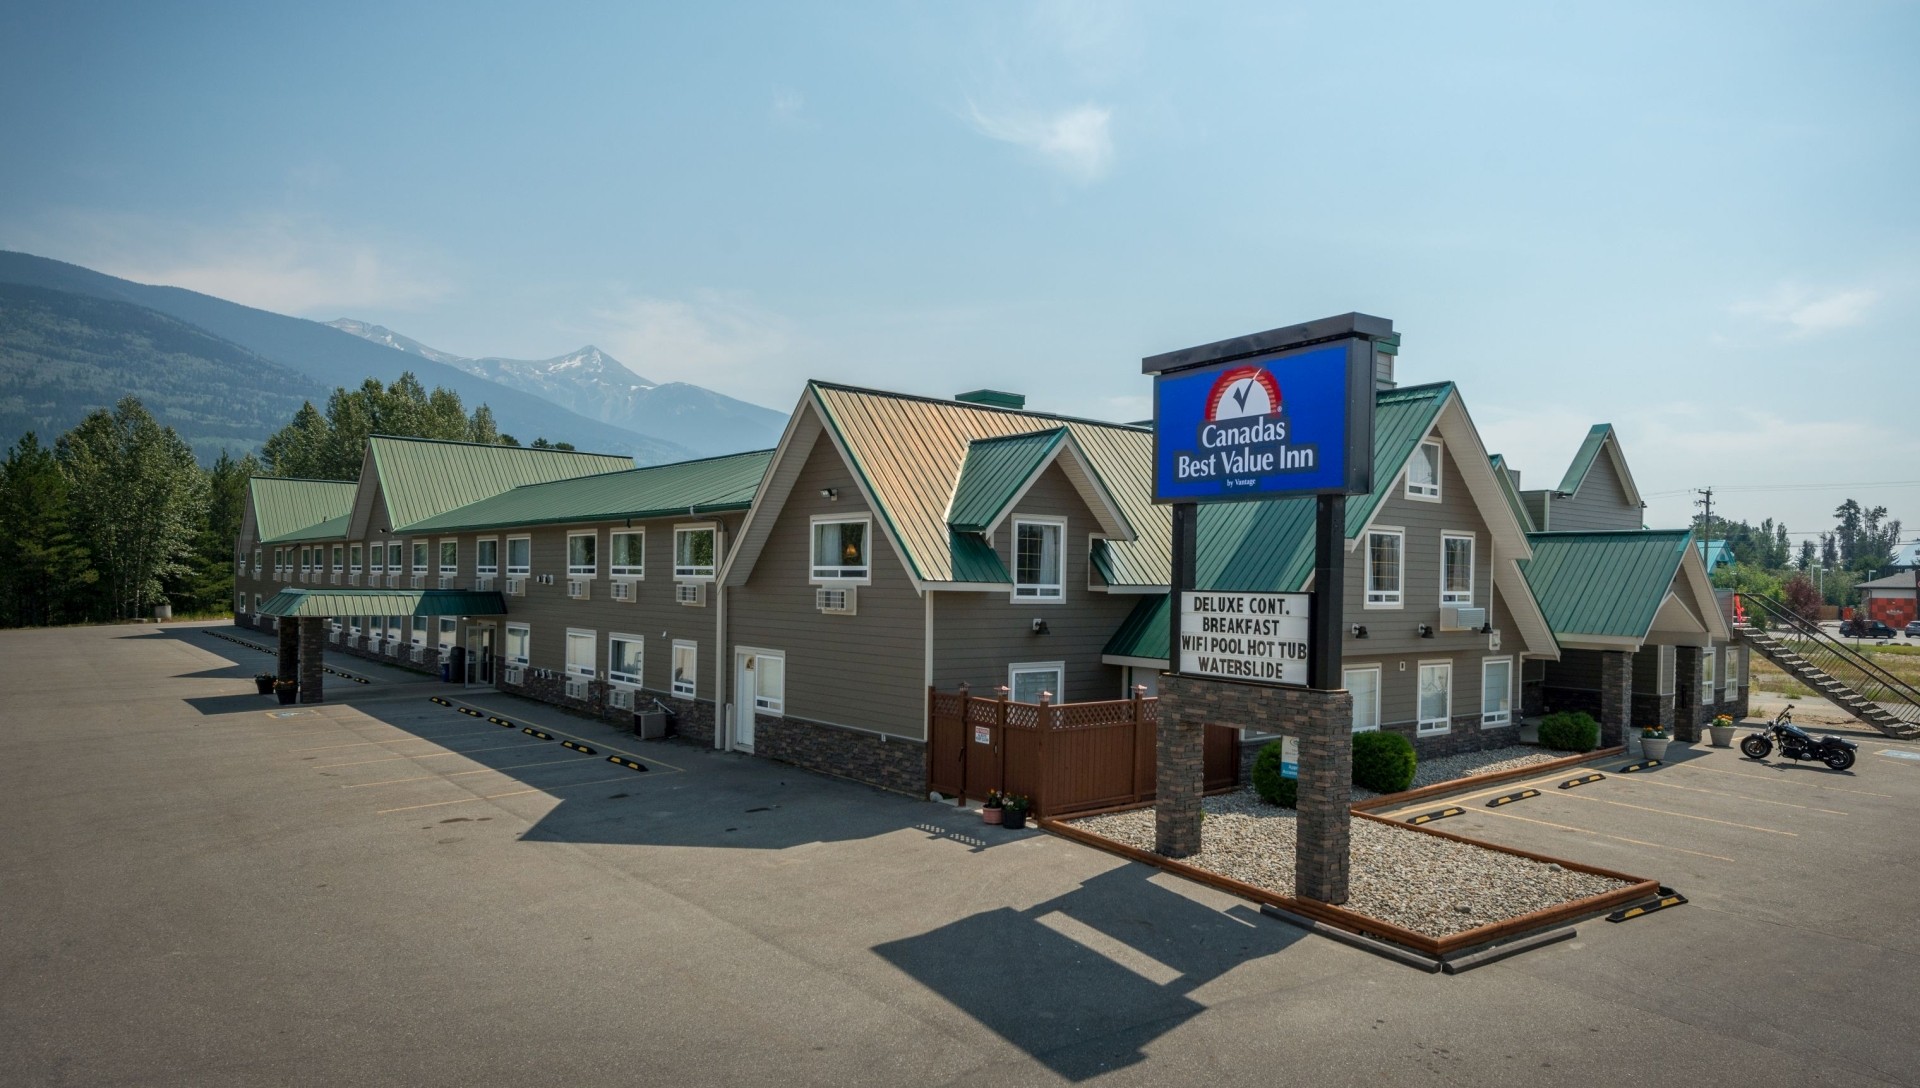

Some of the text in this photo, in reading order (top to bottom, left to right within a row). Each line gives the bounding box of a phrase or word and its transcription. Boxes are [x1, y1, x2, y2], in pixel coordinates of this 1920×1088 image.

[1202, 416, 1285, 448] Canadas
[1178, 445, 1313, 478] Best Value Inn
[1226, 478, 1256, 487] by Vantage
[1194, 597, 1289, 615] DELUXE CONT.
[1203, 617, 1279, 636] BREAKFAST
[1182, 635, 1306, 659] WIFI POOL HOT TUB
[1199, 657, 1282, 679] WATERSLIDE
